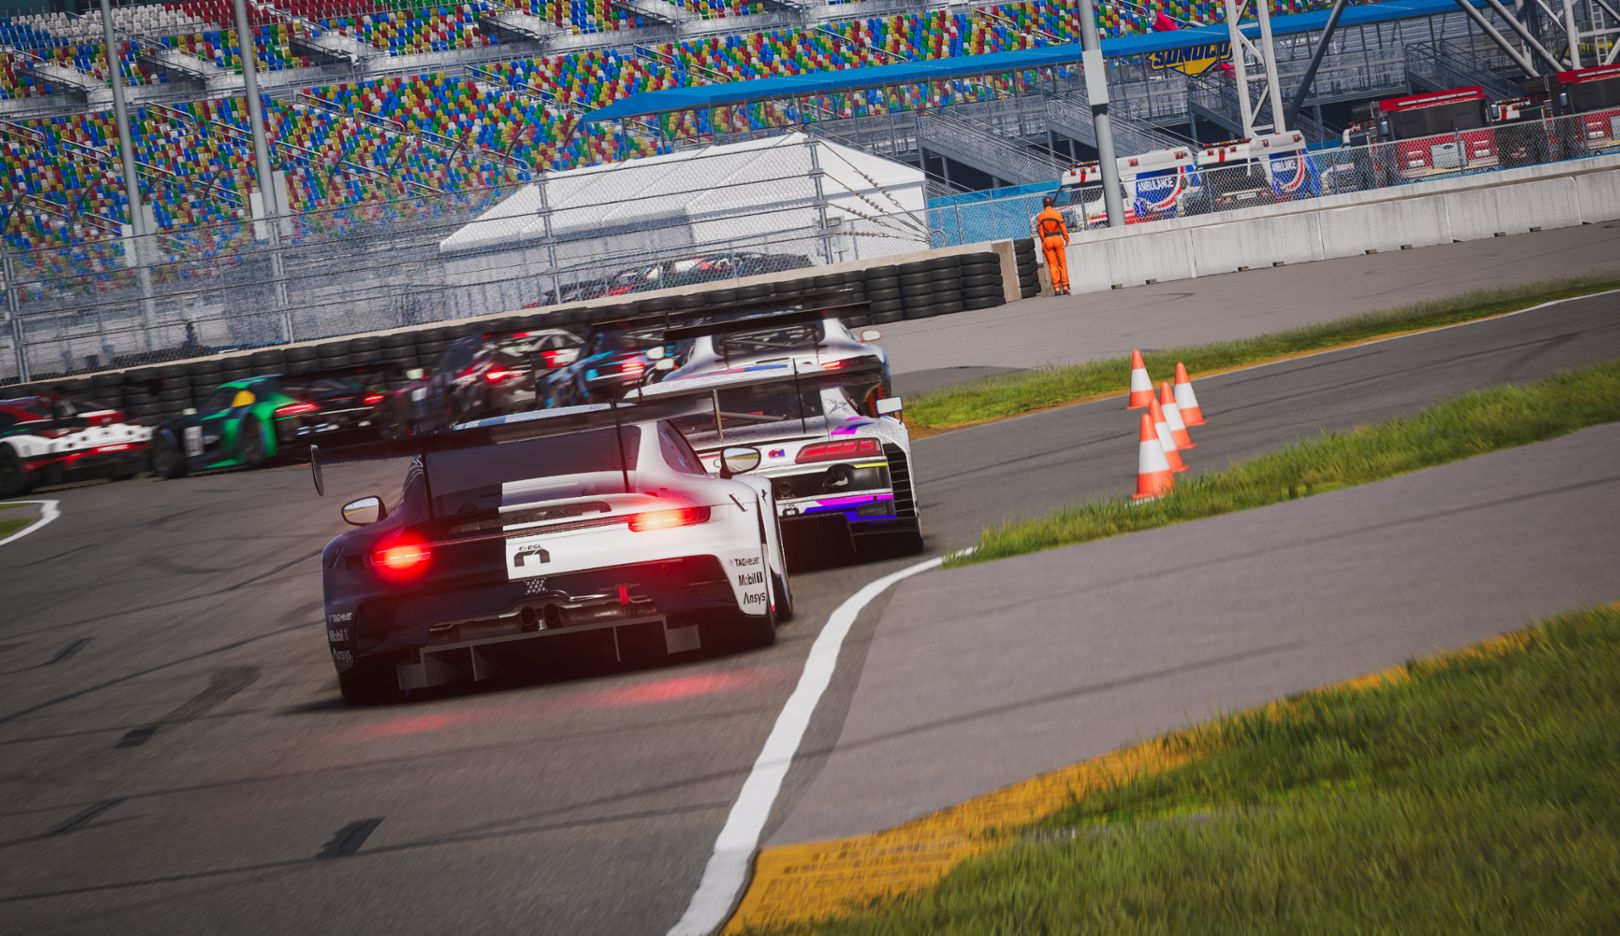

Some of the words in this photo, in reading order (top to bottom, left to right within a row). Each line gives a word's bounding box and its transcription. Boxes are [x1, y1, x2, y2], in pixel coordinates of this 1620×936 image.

[1153, 42, 1230, 66] SUNOCO
[1138, 176, 1174, 192] AMBULANCE
[743, 592, 766, 605] Ansys
